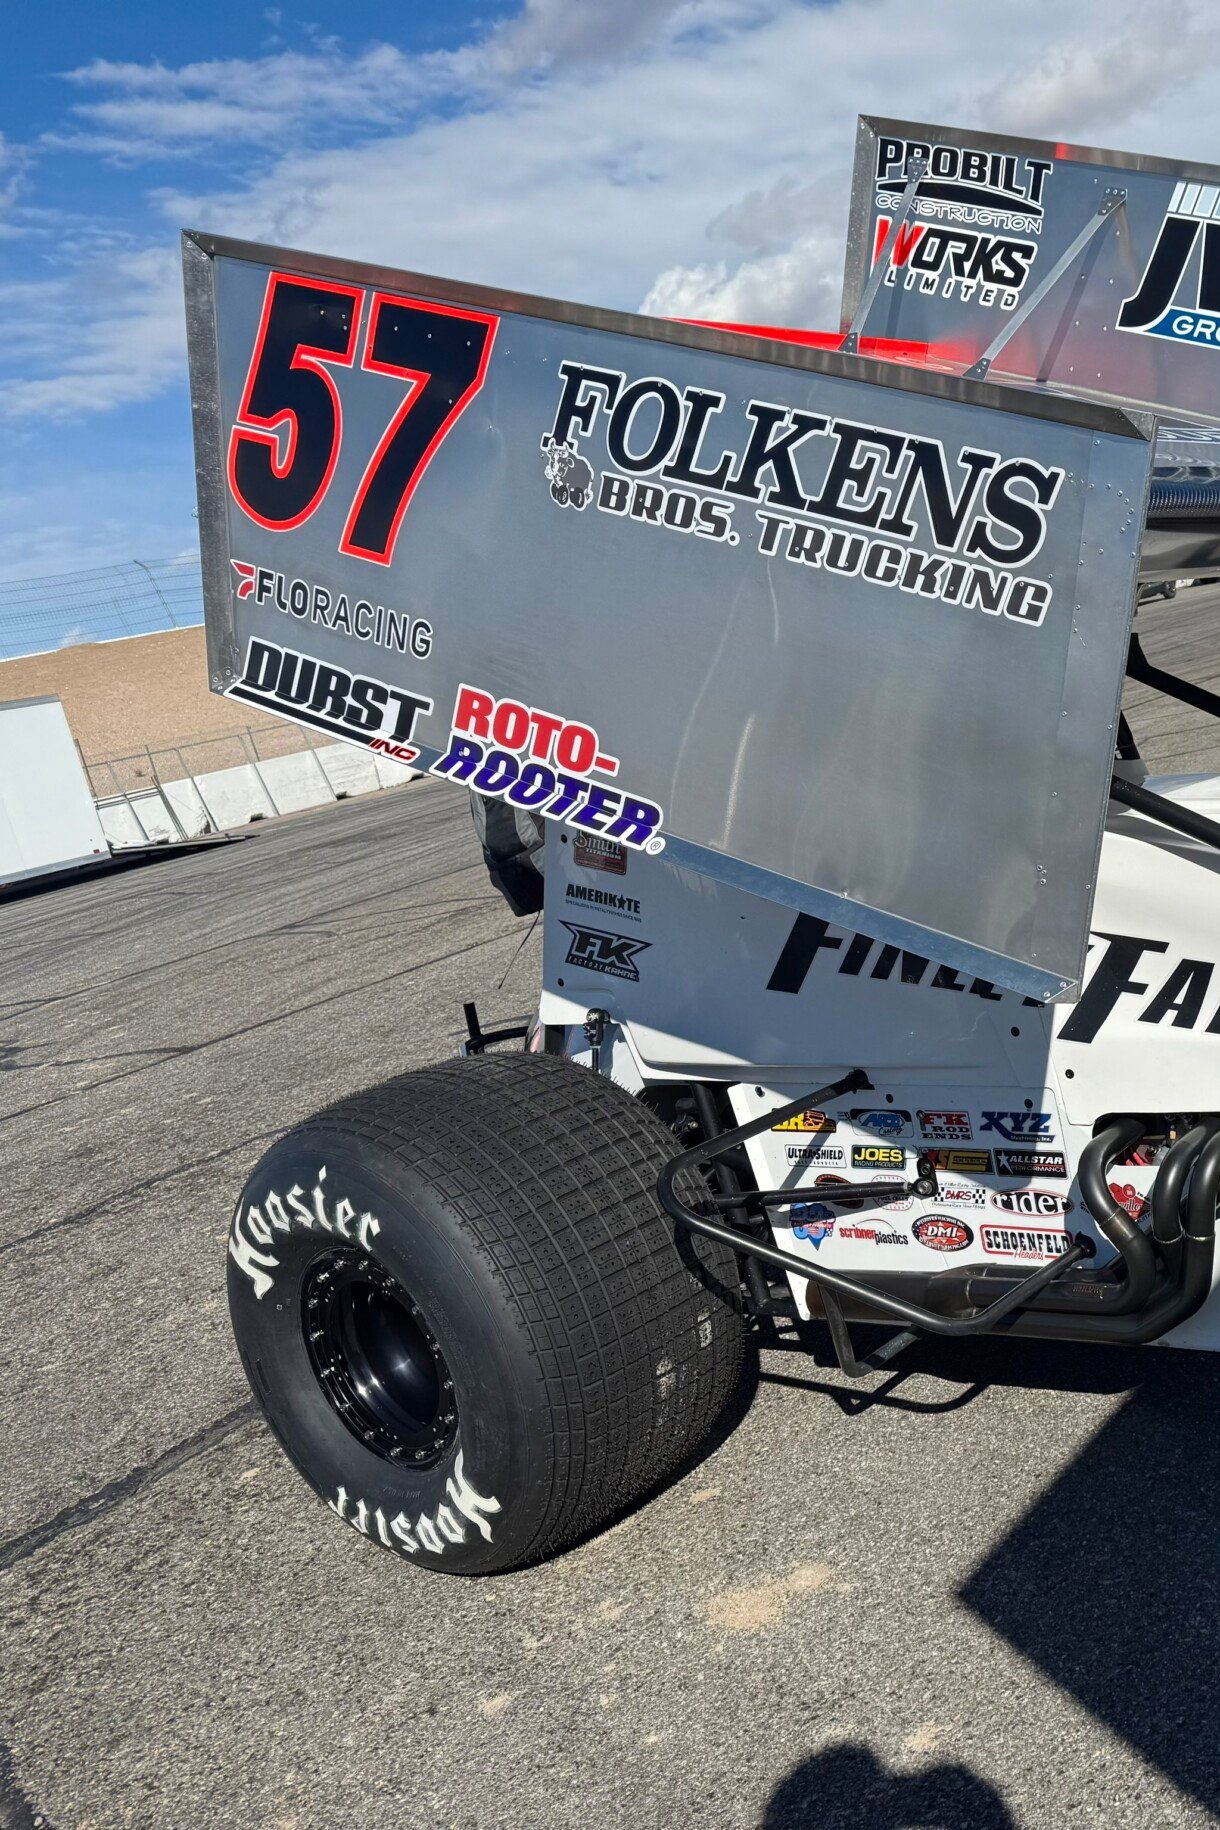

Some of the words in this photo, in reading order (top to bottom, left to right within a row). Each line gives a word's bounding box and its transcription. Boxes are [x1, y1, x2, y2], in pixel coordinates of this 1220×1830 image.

[875, 136, 1053, 205] PROBILT
[870, 215, 1038, 291] WORKS
[884, 266, 1018, 310] LIMITED
[228, 272, 500, 567] 57
[541, 360, 1066, 569] FOLKENS
[597, 471, 740, 546] BROS.
[756, 510, 1052, 627] TRUCKING
[254, 568, 433, 660] FLORACING
[241, 637, 434, 742] DURST
[452, 683, 621, 778] ROTO-
[369, 738, 417, 762] INC
[574, 929, 640, 968] FK
[924, 1112, 969, 1126] FK
[931, 1126, 970, 1134] ROD
[980, 1111, 1052, 1134] XYZ
[922, 1132, 971, 1140] ENDS
[854, 1148, 903, 1162] JOES
[855, 1160, 874, 1168] RACING
[874, 1161, 903, 1169] PRODUCTS
[1010, 1154, 1064, 1165] ALLSTAR
[1011, 1164, 1065, 1173] PERFORMANCE
[228, 1165, 381, 1300] Hoosier
[927, 1225, 958, 1238] DMI
[984, 1229, 1070, 1254] SCHOENFELD
[1013, 1249, 1045, 1261] Headers
[329, 1450, 502, 1555] Hoosier
